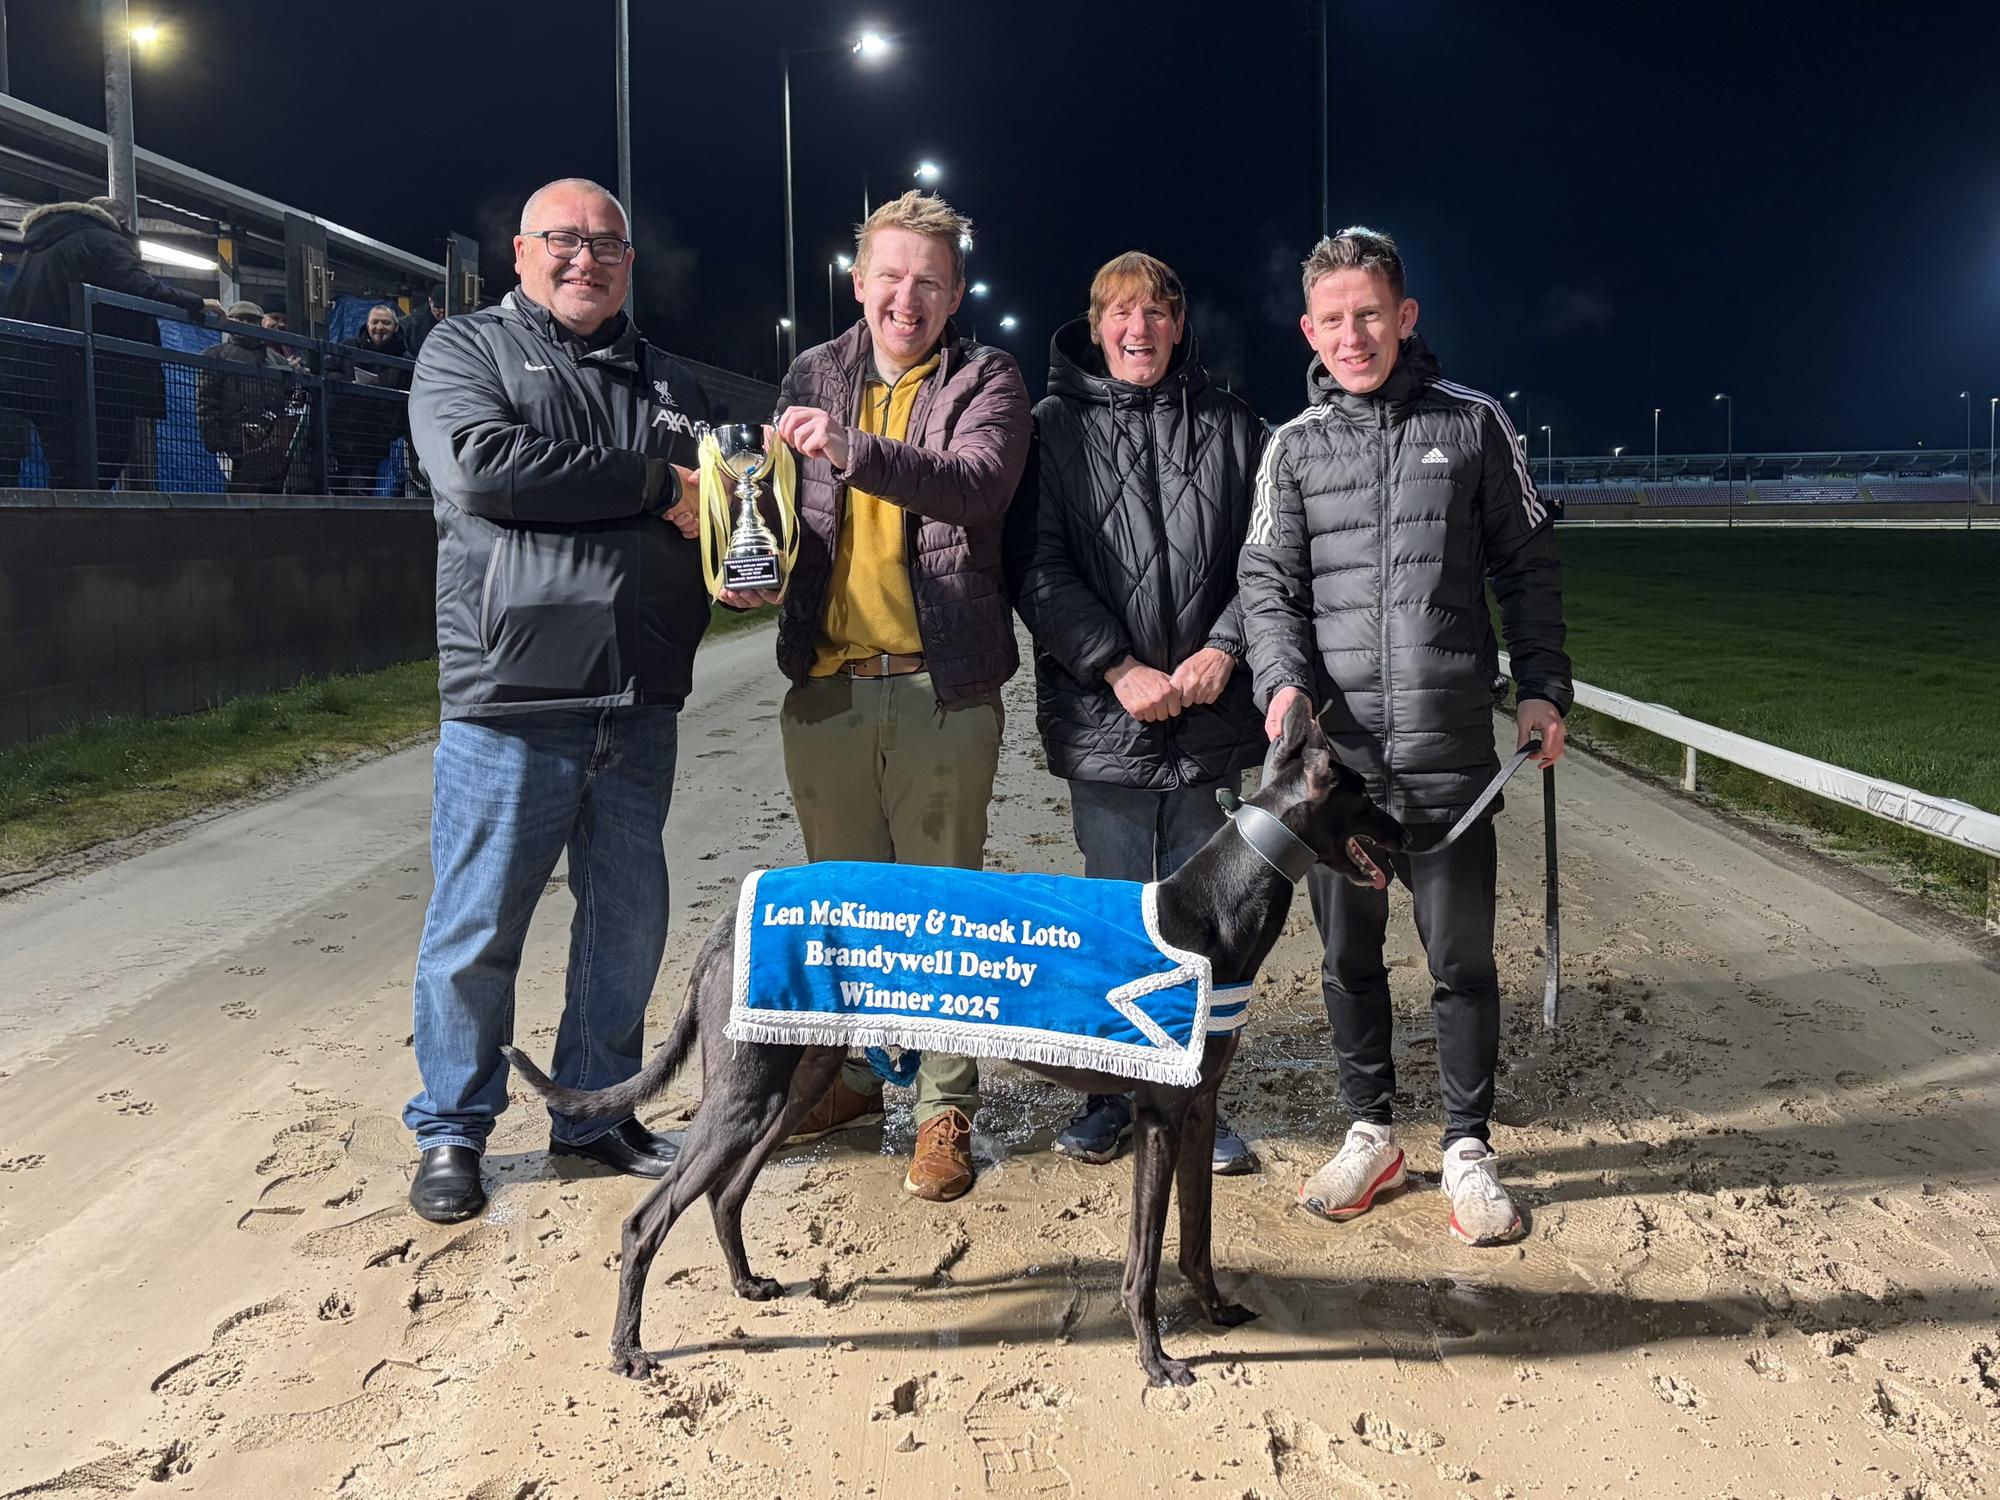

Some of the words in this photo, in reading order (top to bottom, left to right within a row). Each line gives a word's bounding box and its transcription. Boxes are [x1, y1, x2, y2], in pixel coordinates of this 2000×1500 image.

[651, 408, 695, 438] AXA
[762, 903, 805, 926] Len
[809, 900, 922, 937] McKinney
[924, 908, 947, 935] &
[950, 914, 1016, 944] Track
[1021, 919, 1081, 949] Lotto
[804, 940, 953, 975] Brandywell
[958, 952, 1038, 987] Derby
[840, 981, 935, 1012] Winner
[938, 993, 1001, 1021] 2025
